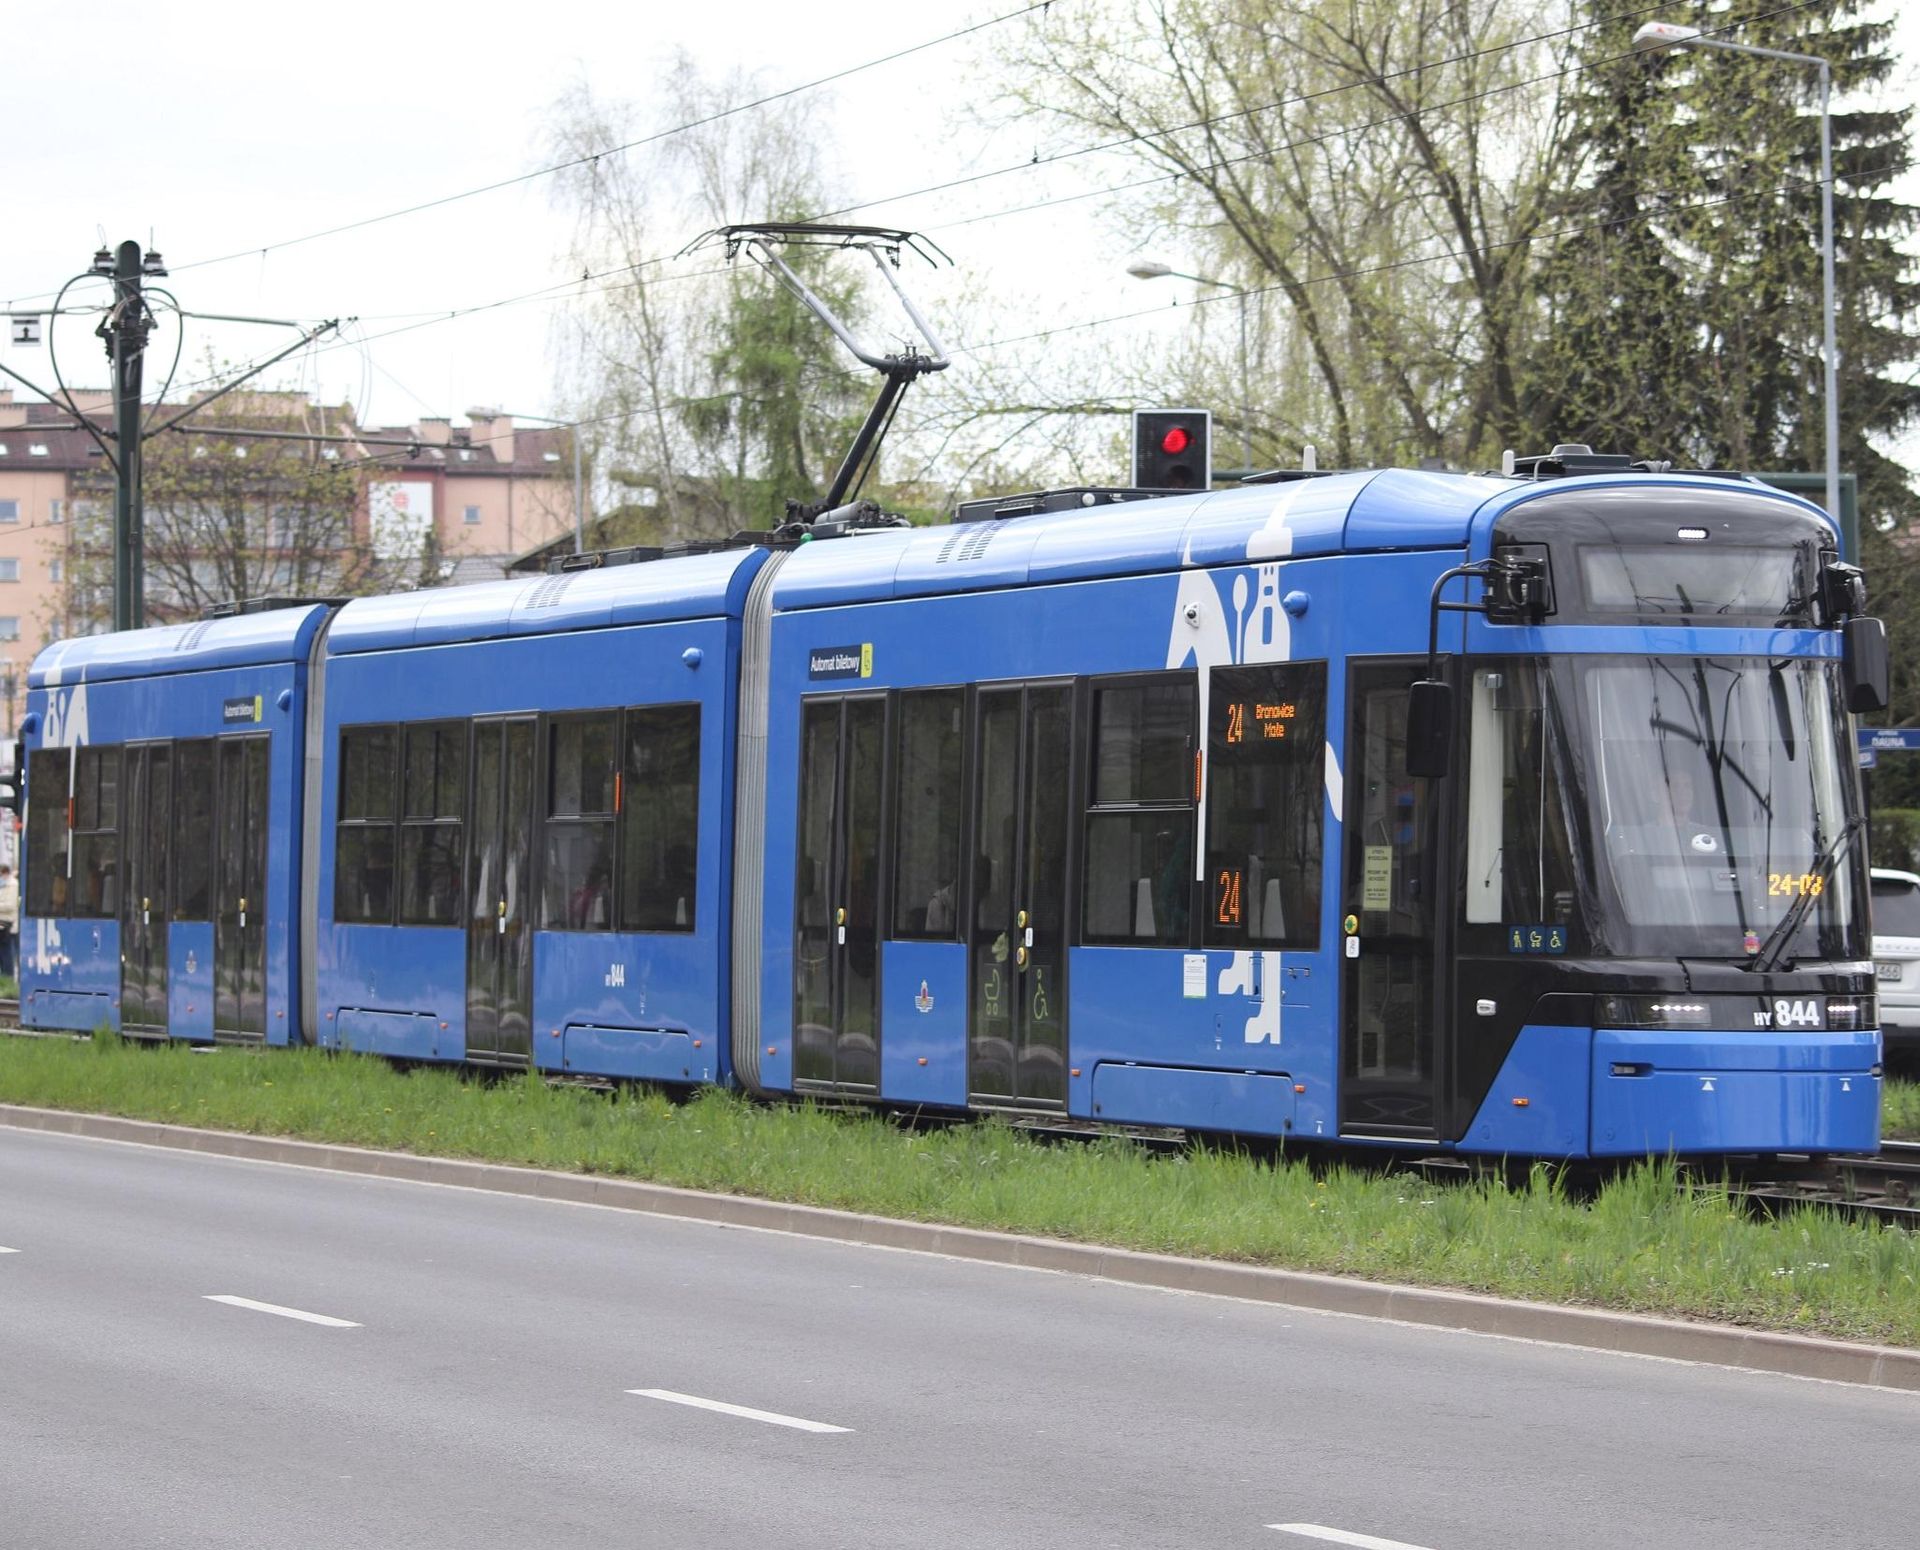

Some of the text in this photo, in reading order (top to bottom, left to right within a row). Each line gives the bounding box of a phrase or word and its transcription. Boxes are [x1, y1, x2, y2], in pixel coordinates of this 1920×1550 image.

[810, 656, 835, 672] Automat
[1227, 703, 1243, 743] 24
[1219, 871, 1241, 923] 24
[1753, 999, 1820, 1026] HY 844
